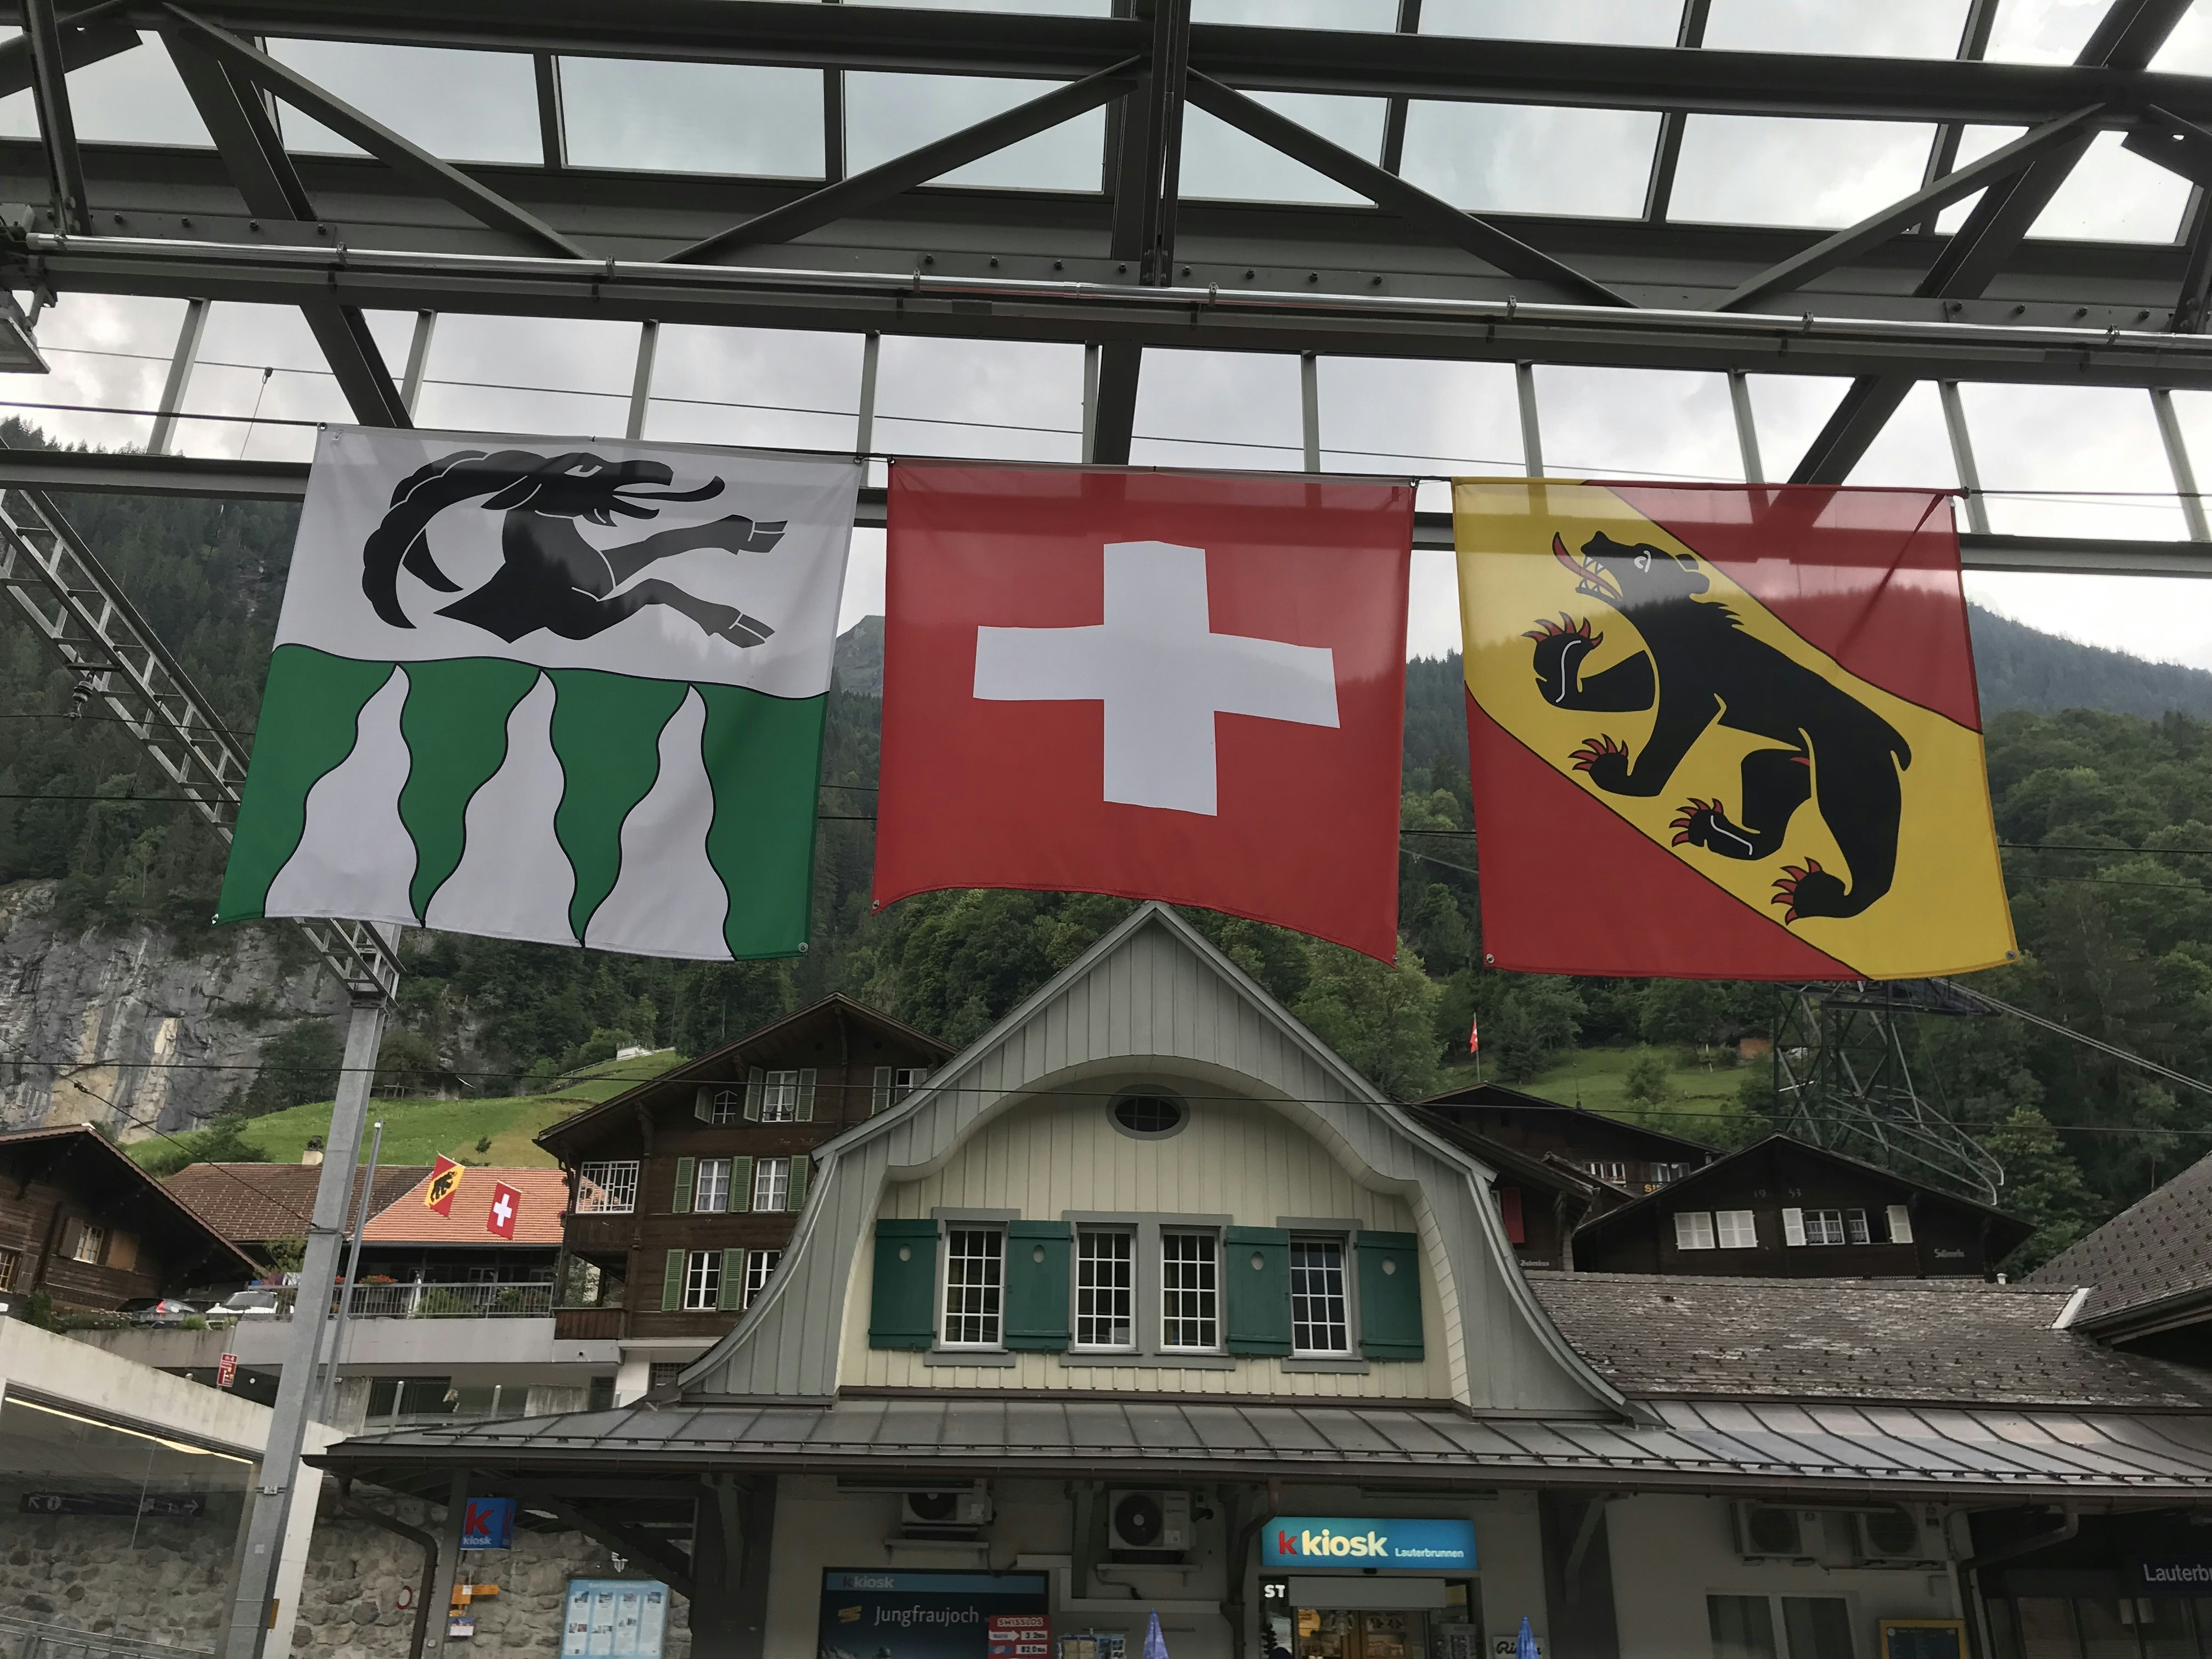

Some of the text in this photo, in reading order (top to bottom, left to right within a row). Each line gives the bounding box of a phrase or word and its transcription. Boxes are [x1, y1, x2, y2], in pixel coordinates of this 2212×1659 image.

[465, 1502, 494, 1535] k
[463, 1536, 492, 1545] kiosk
[1301, 1528, 1389, 1557] kiosk
[1395, 1548, 1464, 1558] Lauterbrunnen
[854, 1575, 895, 1589] kiosk
[873, 1605, 979, 1628] Jungfraujoch
[997, 1617, 1044, 1627] SWISSLOS
